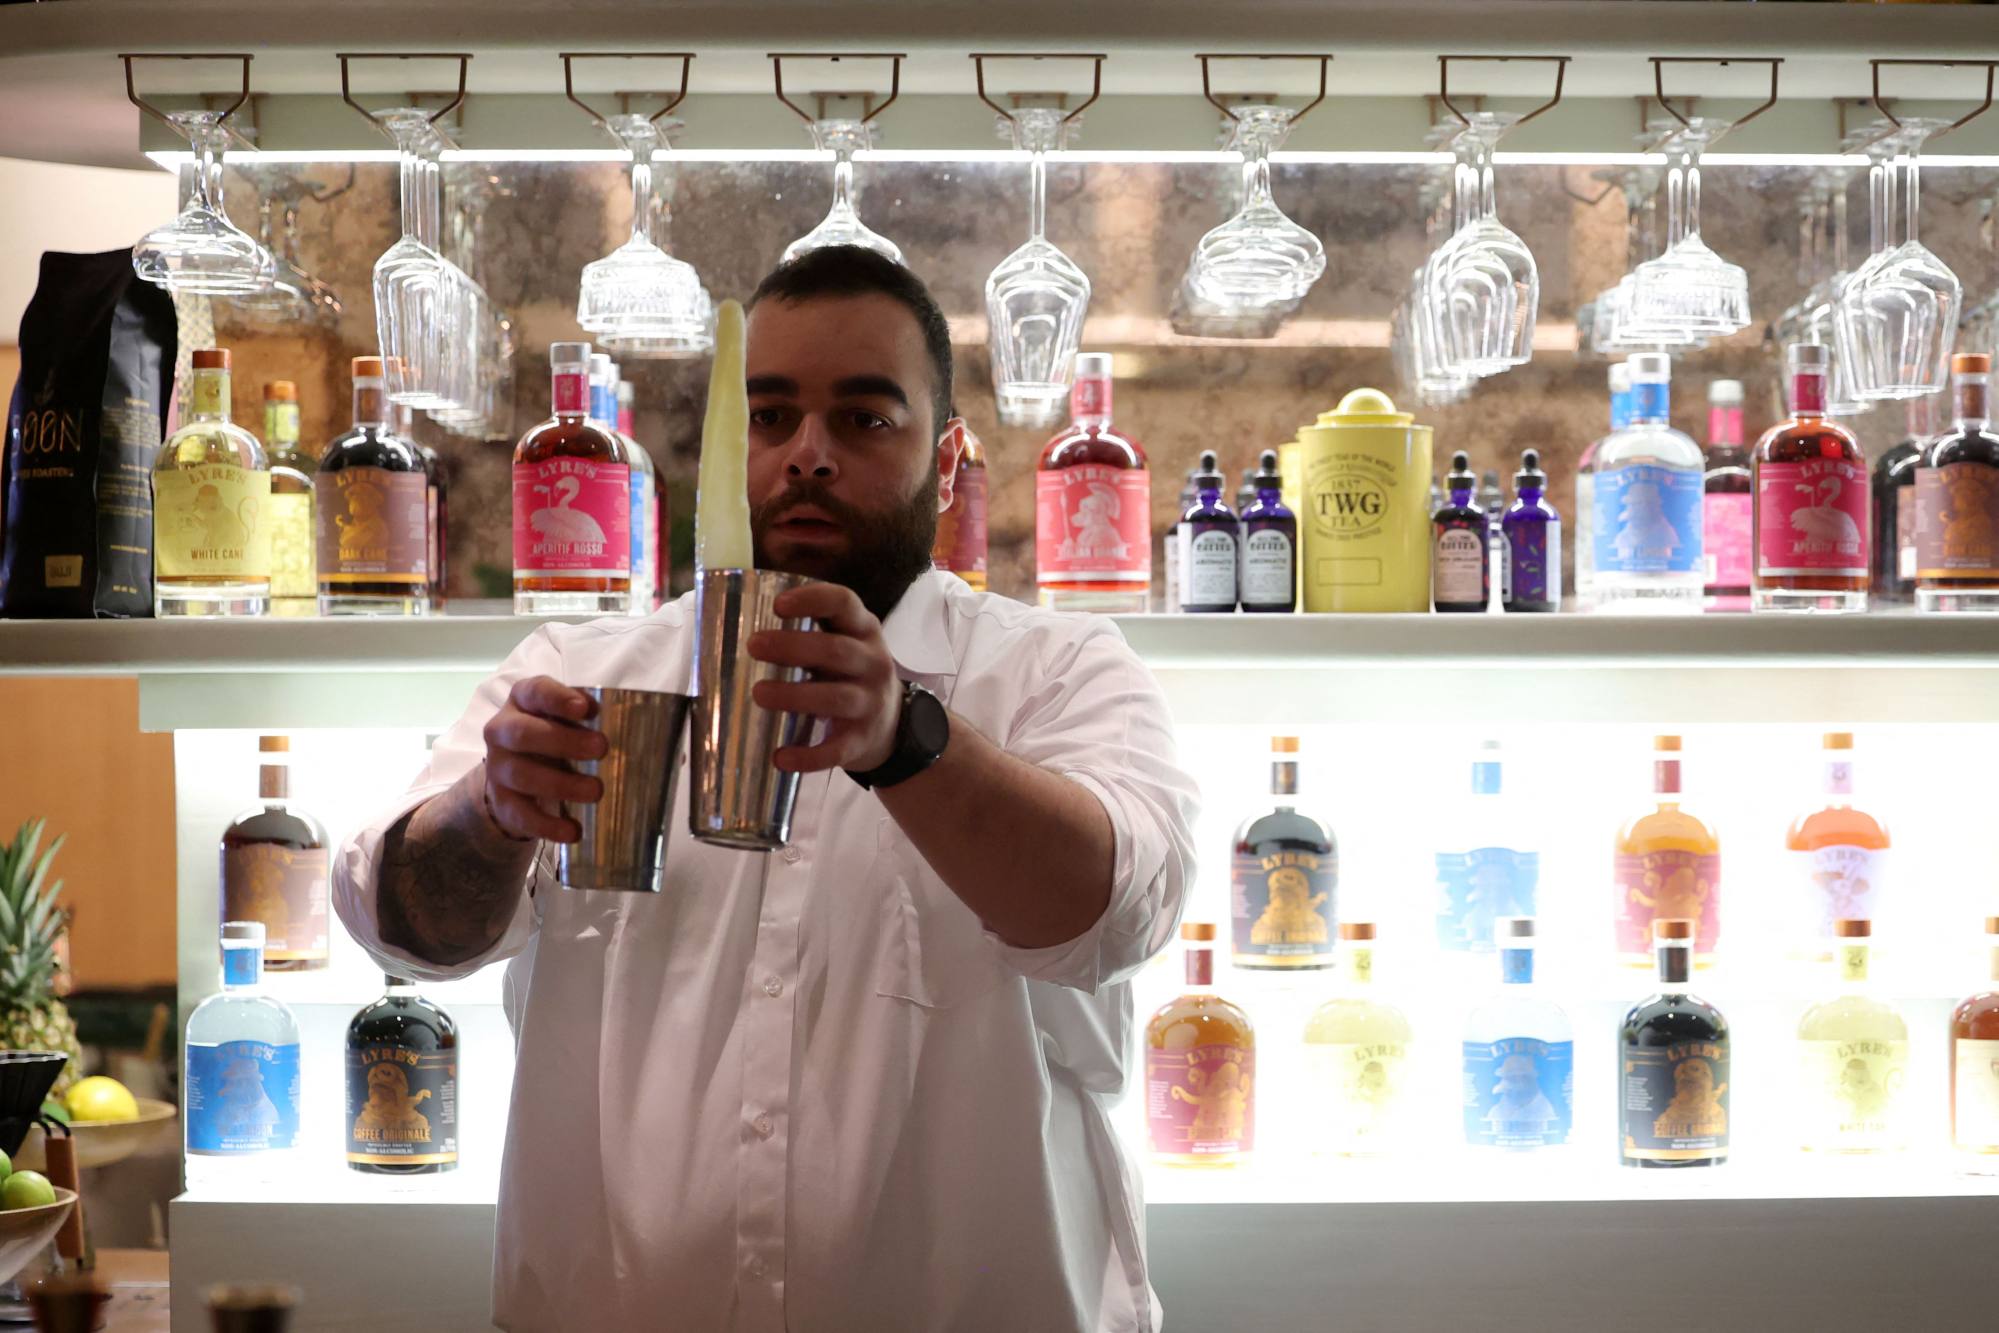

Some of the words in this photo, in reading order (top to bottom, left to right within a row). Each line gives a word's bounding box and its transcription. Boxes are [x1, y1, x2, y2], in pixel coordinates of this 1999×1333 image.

[538, 461, 599, 480] LYRE'S
[1316, 491, 1381, 515] TWG
[1330, 516, 1361, 527] TEA
[191, 548, 218, 560] WHITE
[532, 543, 570, 555] APERITIF
[574, 543, 603, 555] ROSSO
[361, 1048, 421, 1066] LYRE'S
[353, 1127, 381, 1141] COFFEE
[383, 1126, 431, 1141] ORIGINALE
